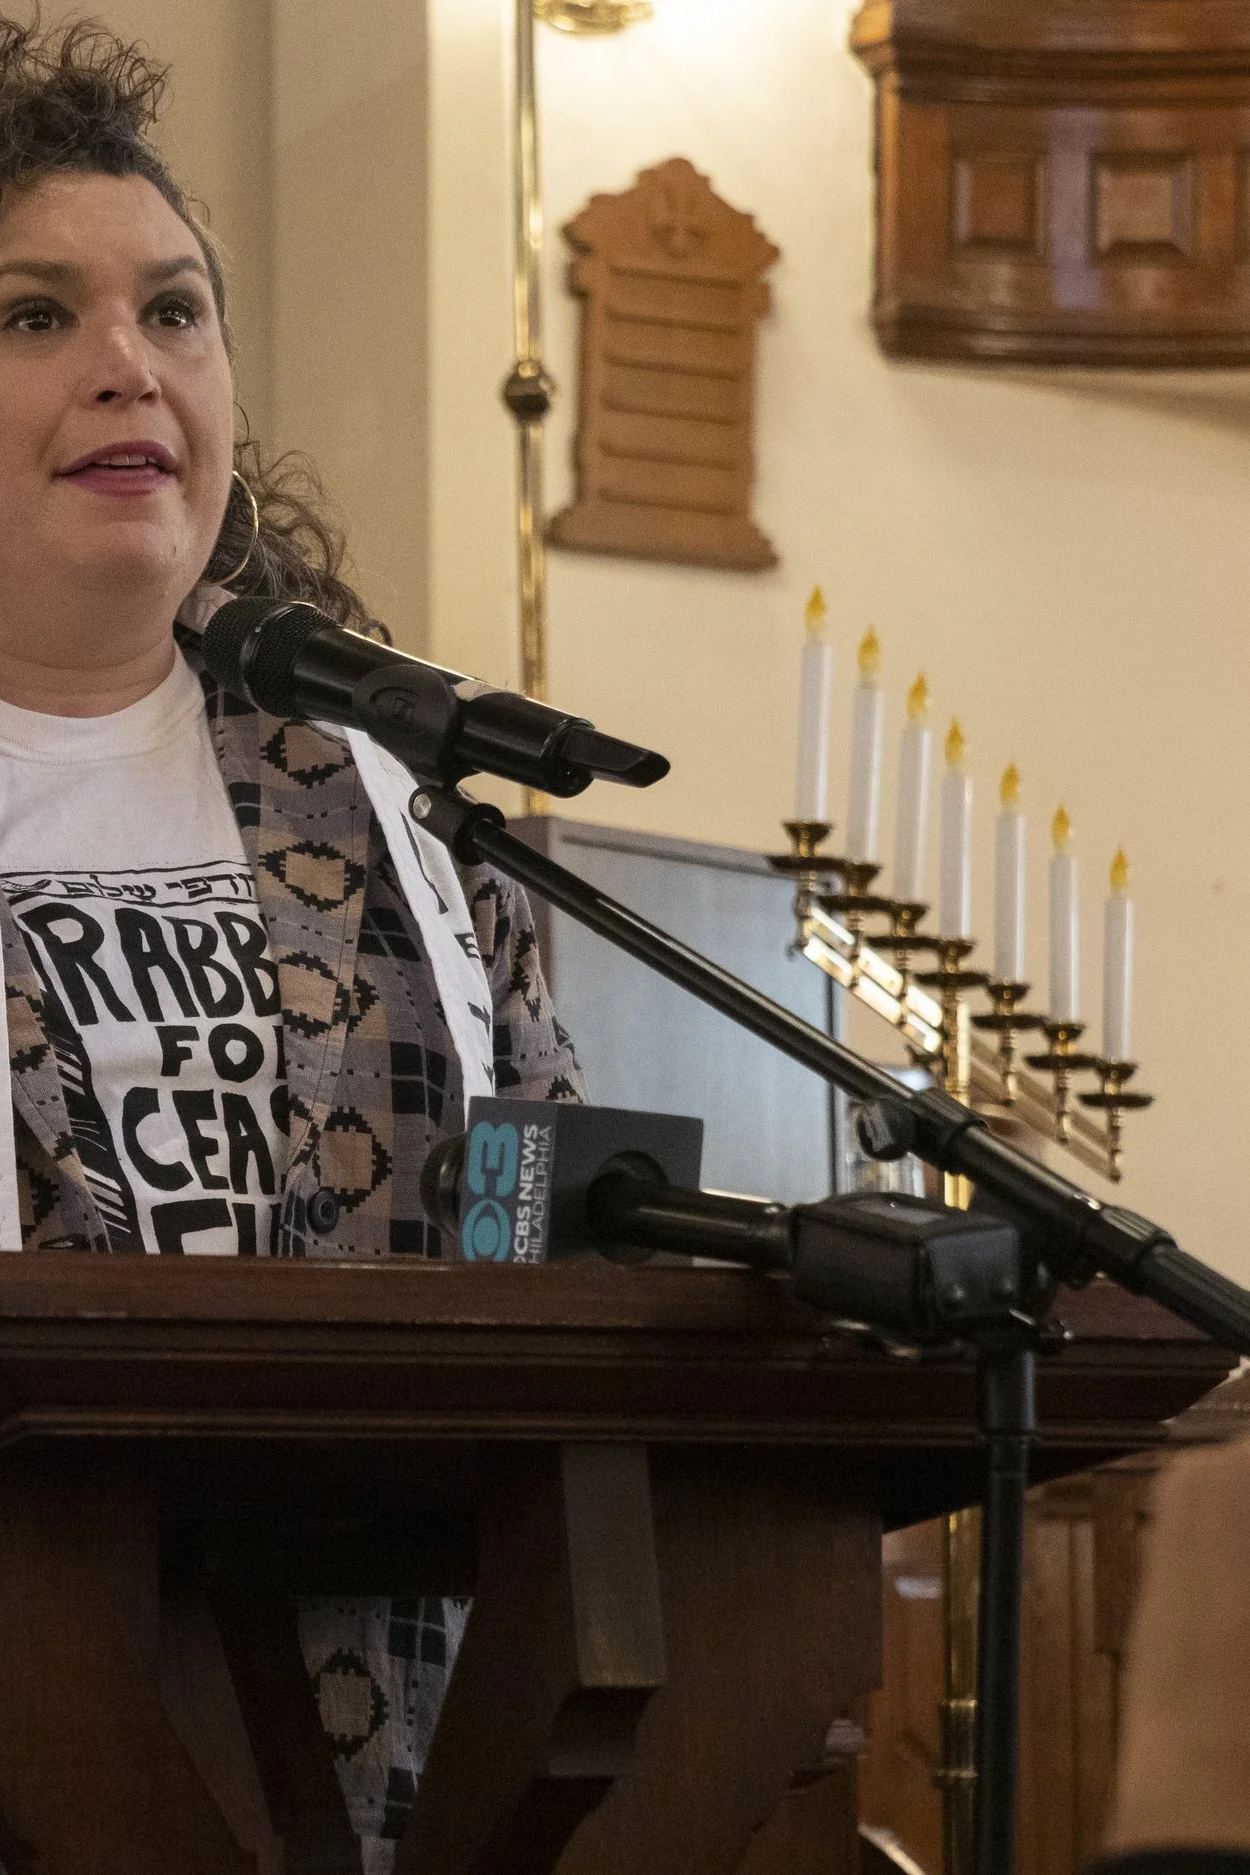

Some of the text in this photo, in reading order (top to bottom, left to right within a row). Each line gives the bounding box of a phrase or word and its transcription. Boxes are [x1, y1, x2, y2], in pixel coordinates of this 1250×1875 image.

[54, 872, 257, 901] ודפי שלום
[17, 902, 284, 1027] RABB
[155, 1022, 288, 1084] FO
[467, 1120, 518, 1197] 3
[513, 1123, 538, 1256] CBS NEWS
[527, 1126, 552, 1264] HILADELPHIA
